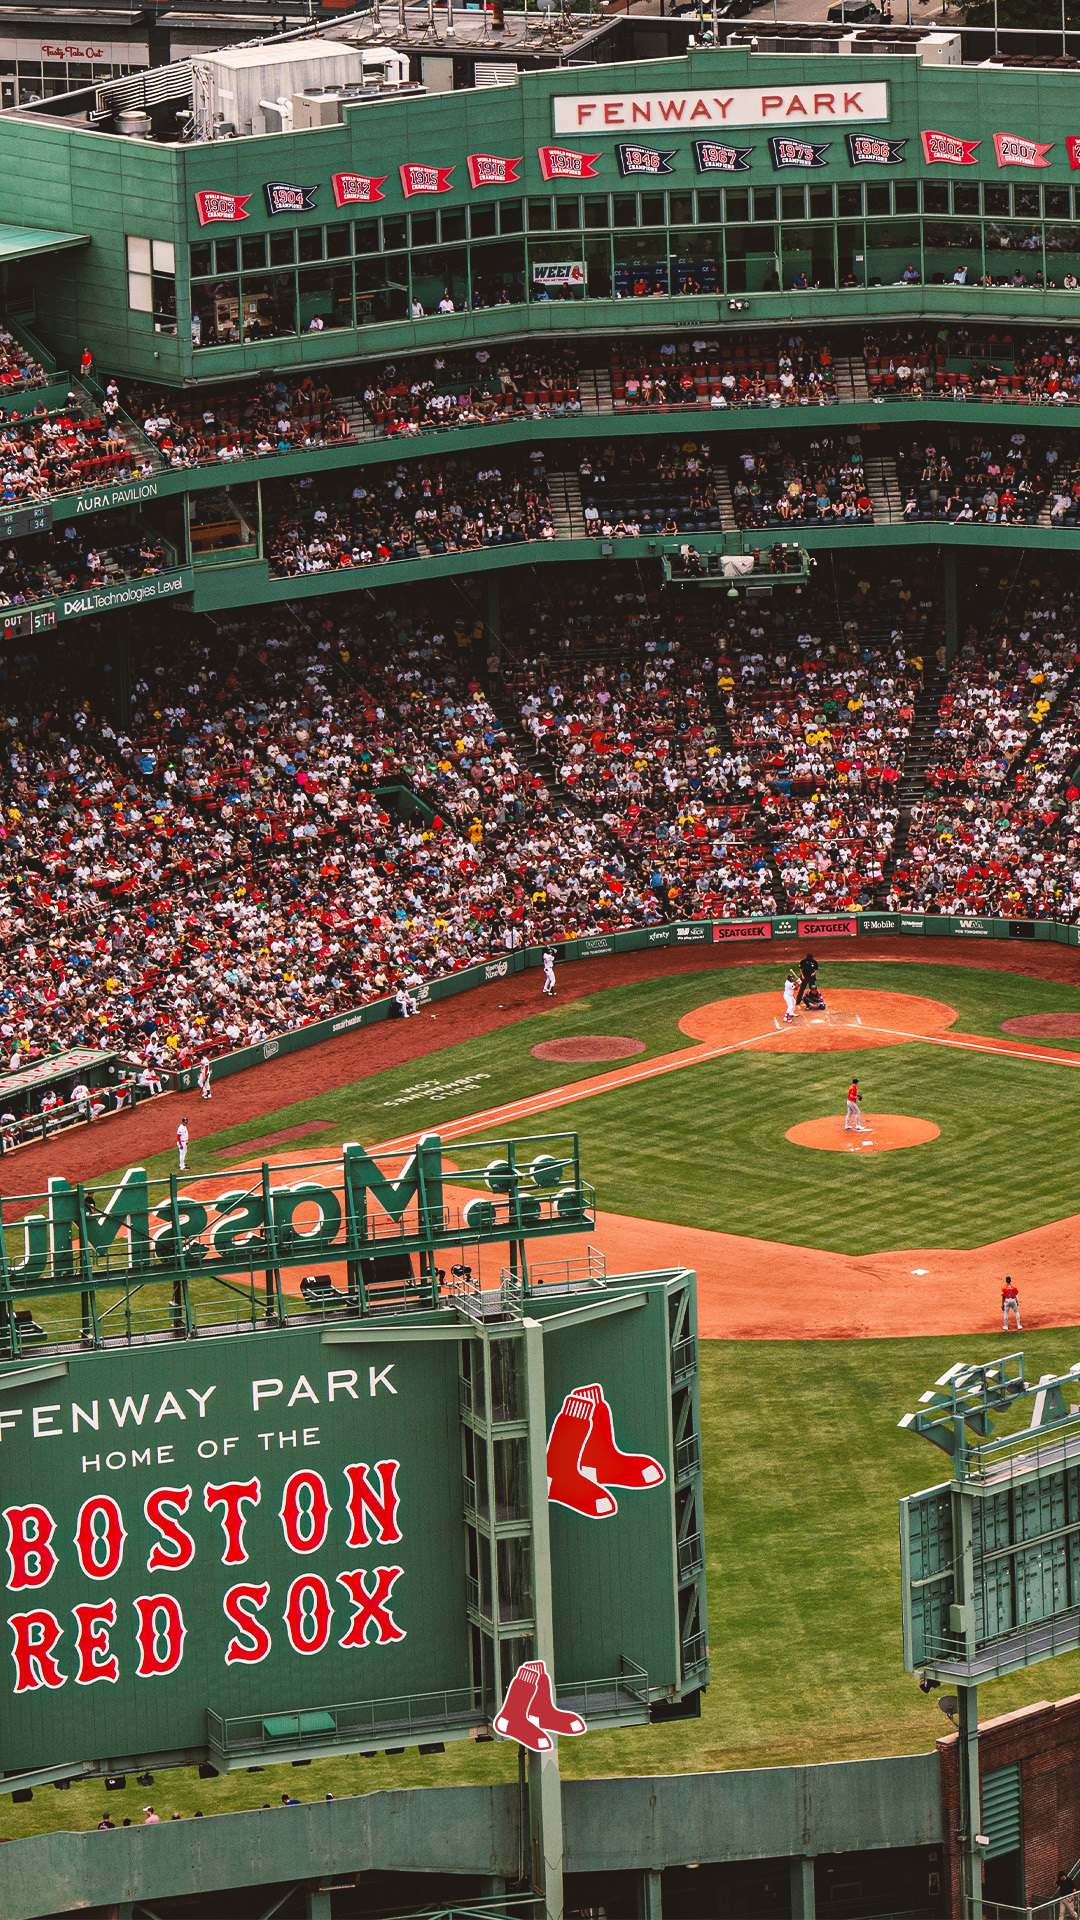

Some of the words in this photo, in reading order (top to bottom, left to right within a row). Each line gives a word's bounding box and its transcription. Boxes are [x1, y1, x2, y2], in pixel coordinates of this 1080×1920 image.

[42, 45, 65, 59] Tasty
[65, 46, 84, 58] Take
[86, 47, 104, 58] Out
[577, 97, 734, 125] FENWAY
[761, 91, 864, 116] PARK
[779, 144, 814, 160] 1975
[855, 141, 890, 157] 1986
[929, 139, 964, 157] 2004
[1000, 142, 1037, 160] 2007
[550, 155, 582, 170] 1918
[626, 152, 660, 168] 1946
[702, 149, 736, 164] 1967
[478, 163, 505, 175] 1916
[410, 171, 438, 185] 1915
[343, 181, 370, 194] 1912
[273, 190, 303, 204] 1904
[205, 199, 235, 214] 1903
[535, 266, 572, 278] WEEI
[112, 483, 158, 505] PAVILION
[7, 526, 12, 535] 6
[34, 518, 44, 529] 34
[64, 598, 94, 615] DELL
[93, 586, 156, 608] Technologies
[158, 576, 183, 594] Level
[4, 616, 22, 628] OUT
[34, 612, 55, 628] 5TH
[718, 926, 765, 938] SEATGEEK
[804, 922, 850, 934] SEATGEEK
[649, 932, 670, 941] xfinity
[333, 1015, 362, 1032] smartwater
[0, 1385, 217, 1442] FENWAY
[252, 1364, 398, 1412] PARK
[82, 1444, 175, 1474] HOME
[197, 1436, 239, 1459] OF
[257, 1427, 321, 1451] THE
[2, 1458, 404, 1592] BOSTON
[6, 1593, 188, 1694] RED
[222, 1565, 408, 1666] SOX
